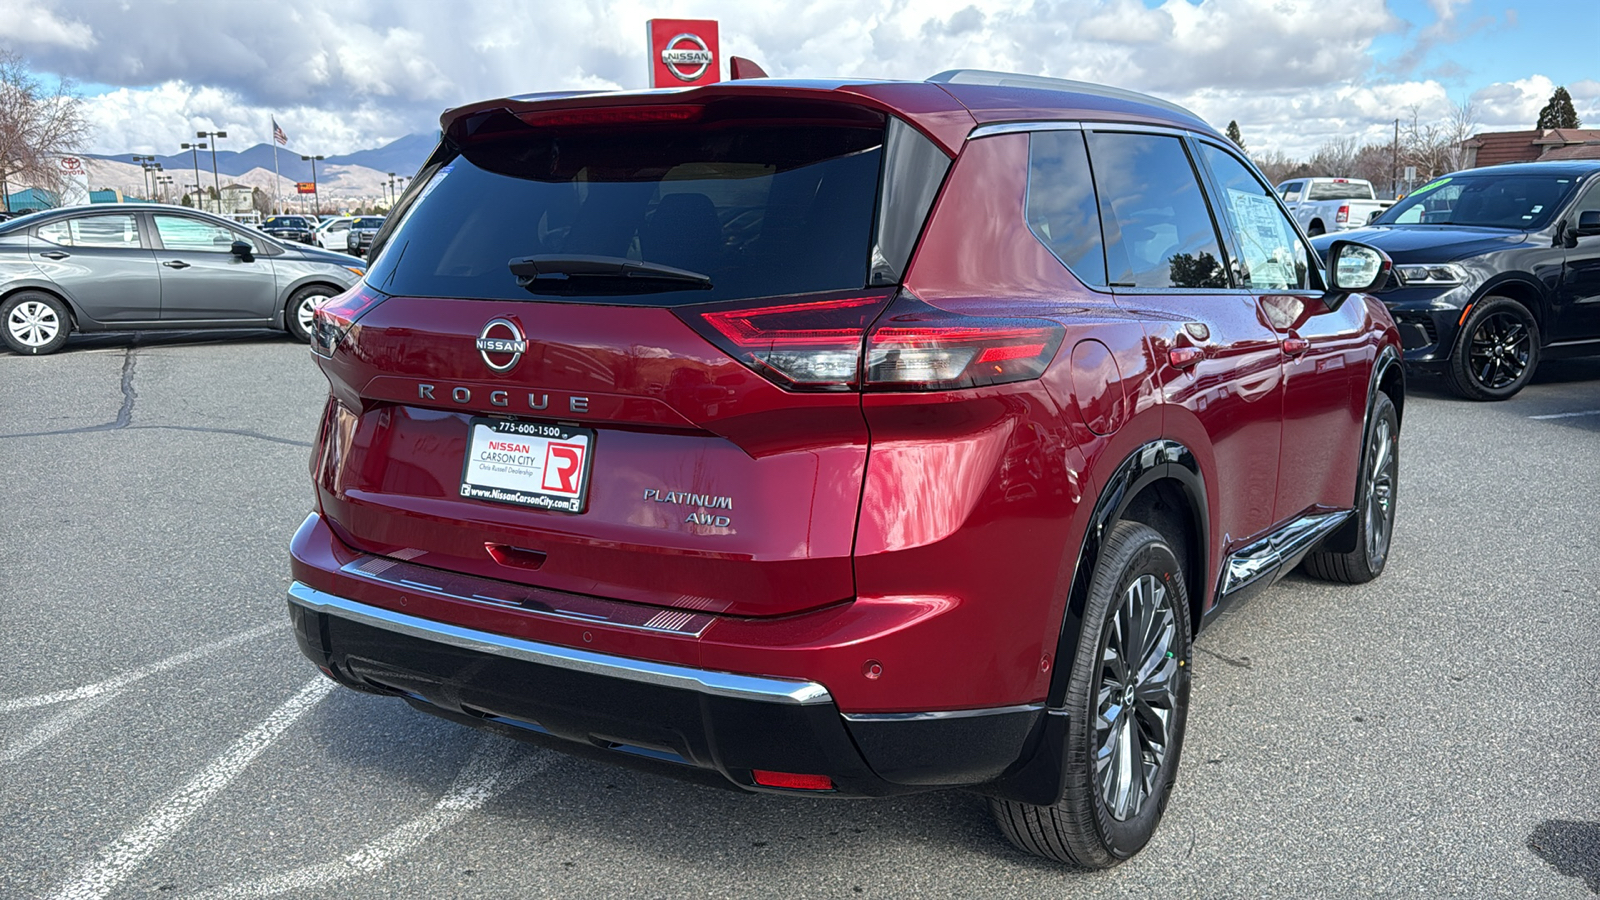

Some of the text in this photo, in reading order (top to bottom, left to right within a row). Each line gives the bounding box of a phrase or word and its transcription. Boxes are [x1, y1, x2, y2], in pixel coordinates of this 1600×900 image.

[668, 52, 709, 61] NISSAN
[476, 340, 525, 352] NISSAN
[418, 383, 590, 413] ROGUE
[499, 422, 560, 437] 775-600-1500
[488, 441, 530, 454] NISSAN
[480, 451, 536, 466] CARSON CITY
[479, 463, 534, 478] Chris Russell Dealership
[470, 488, 570, 509] www.NissanCarsonCity.com
[643, 488, 733, 510] PLATINUM
[685, 512, 731, 527] AWD
